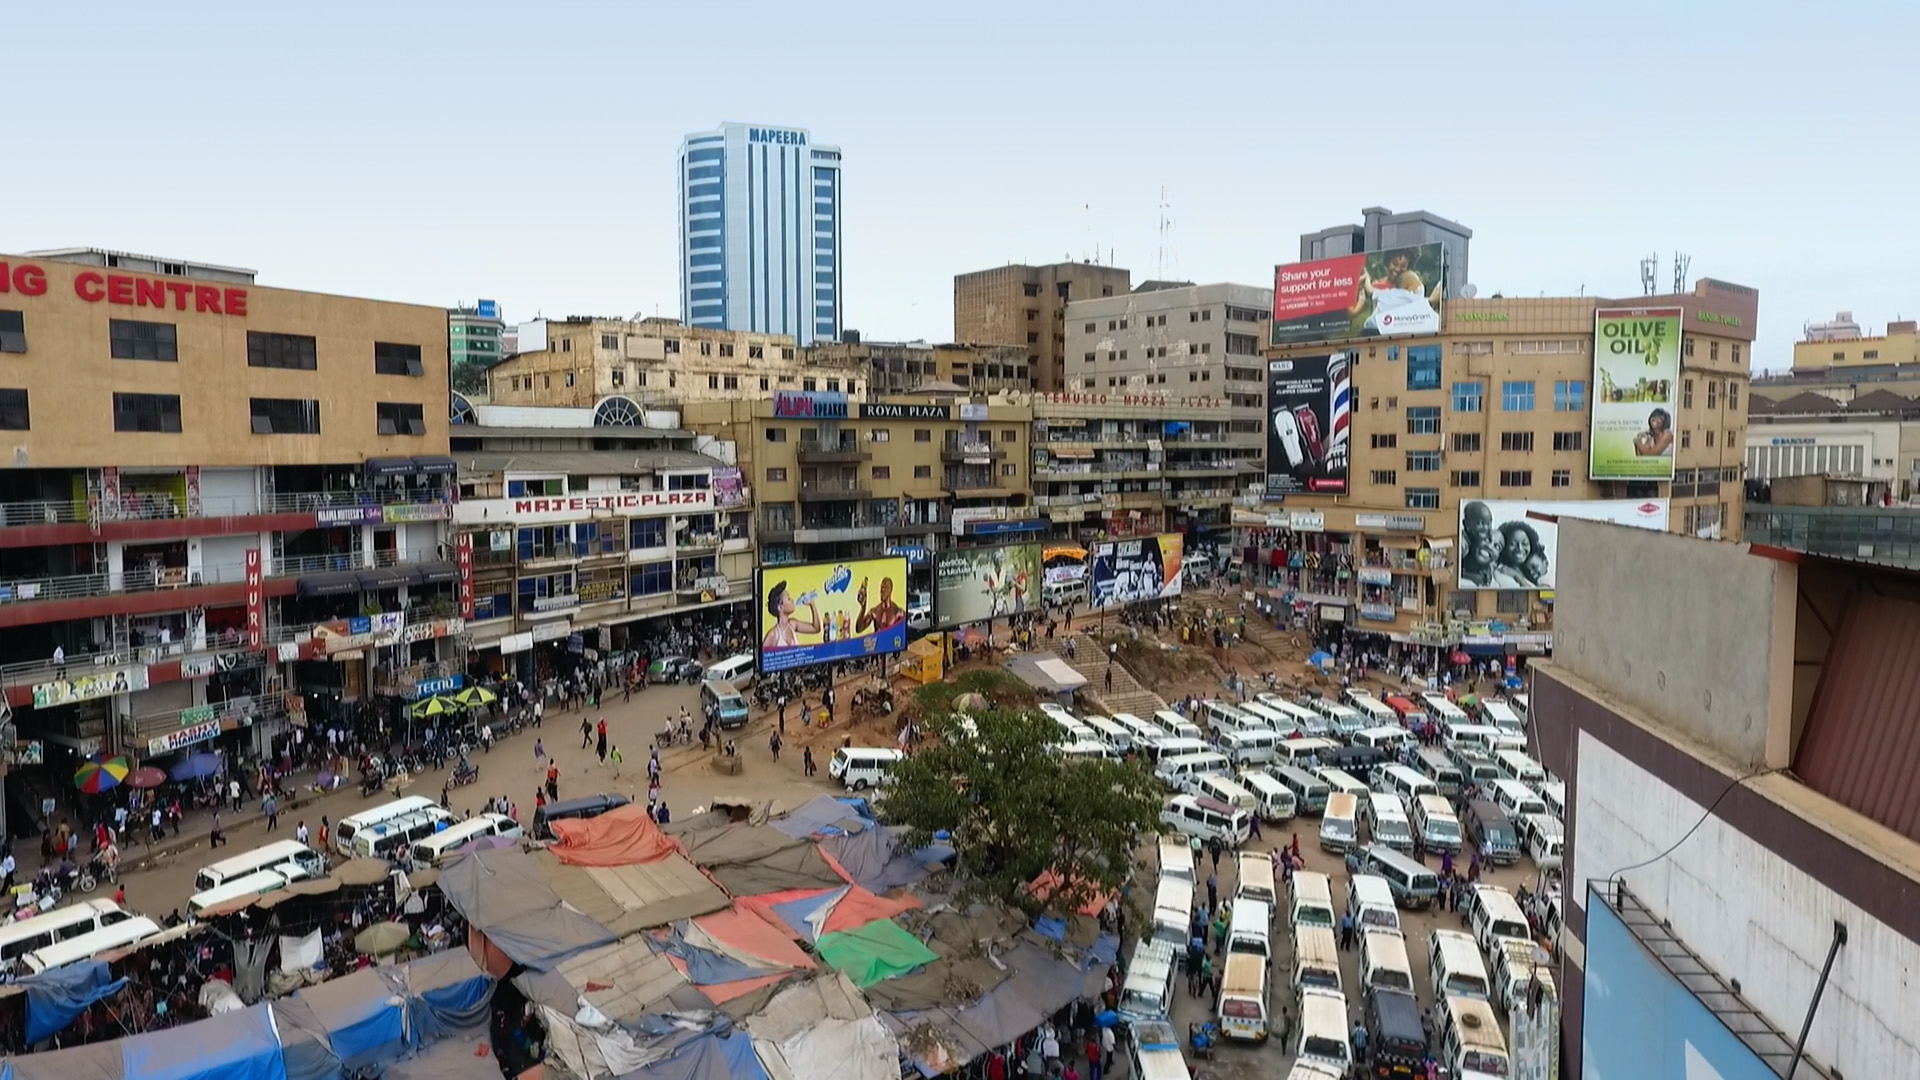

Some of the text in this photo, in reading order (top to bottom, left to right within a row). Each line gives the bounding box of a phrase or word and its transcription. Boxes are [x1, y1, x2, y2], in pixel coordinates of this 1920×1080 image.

[749, 128, 806, 146] MAPEERA
[1281, 268, 1331, 282] Share your
[75, 271, 248, 316] CENTRE
[1281, 277, 1353, 295] support for less
[1603, 321, 1666, 338] OLIVE
[1610, 339, 1645, 354] OIL
[813, 402, 847, 417] SPEAKER
[1124, 395, 1166, 406] MPOZA
[1180, 396, 1221, 408] PLAZA
[867, 405, 944, 417] ROYAL PLAZA
[515, 492, 707, 514] MAJESTIC PLAZA
[459, 534, 470, 614] UHURU
[248, 551, 259, 646] UHURU
[417, 678, 454, 695] TECNO
[169, 728, 219, 749] PHARMACY
